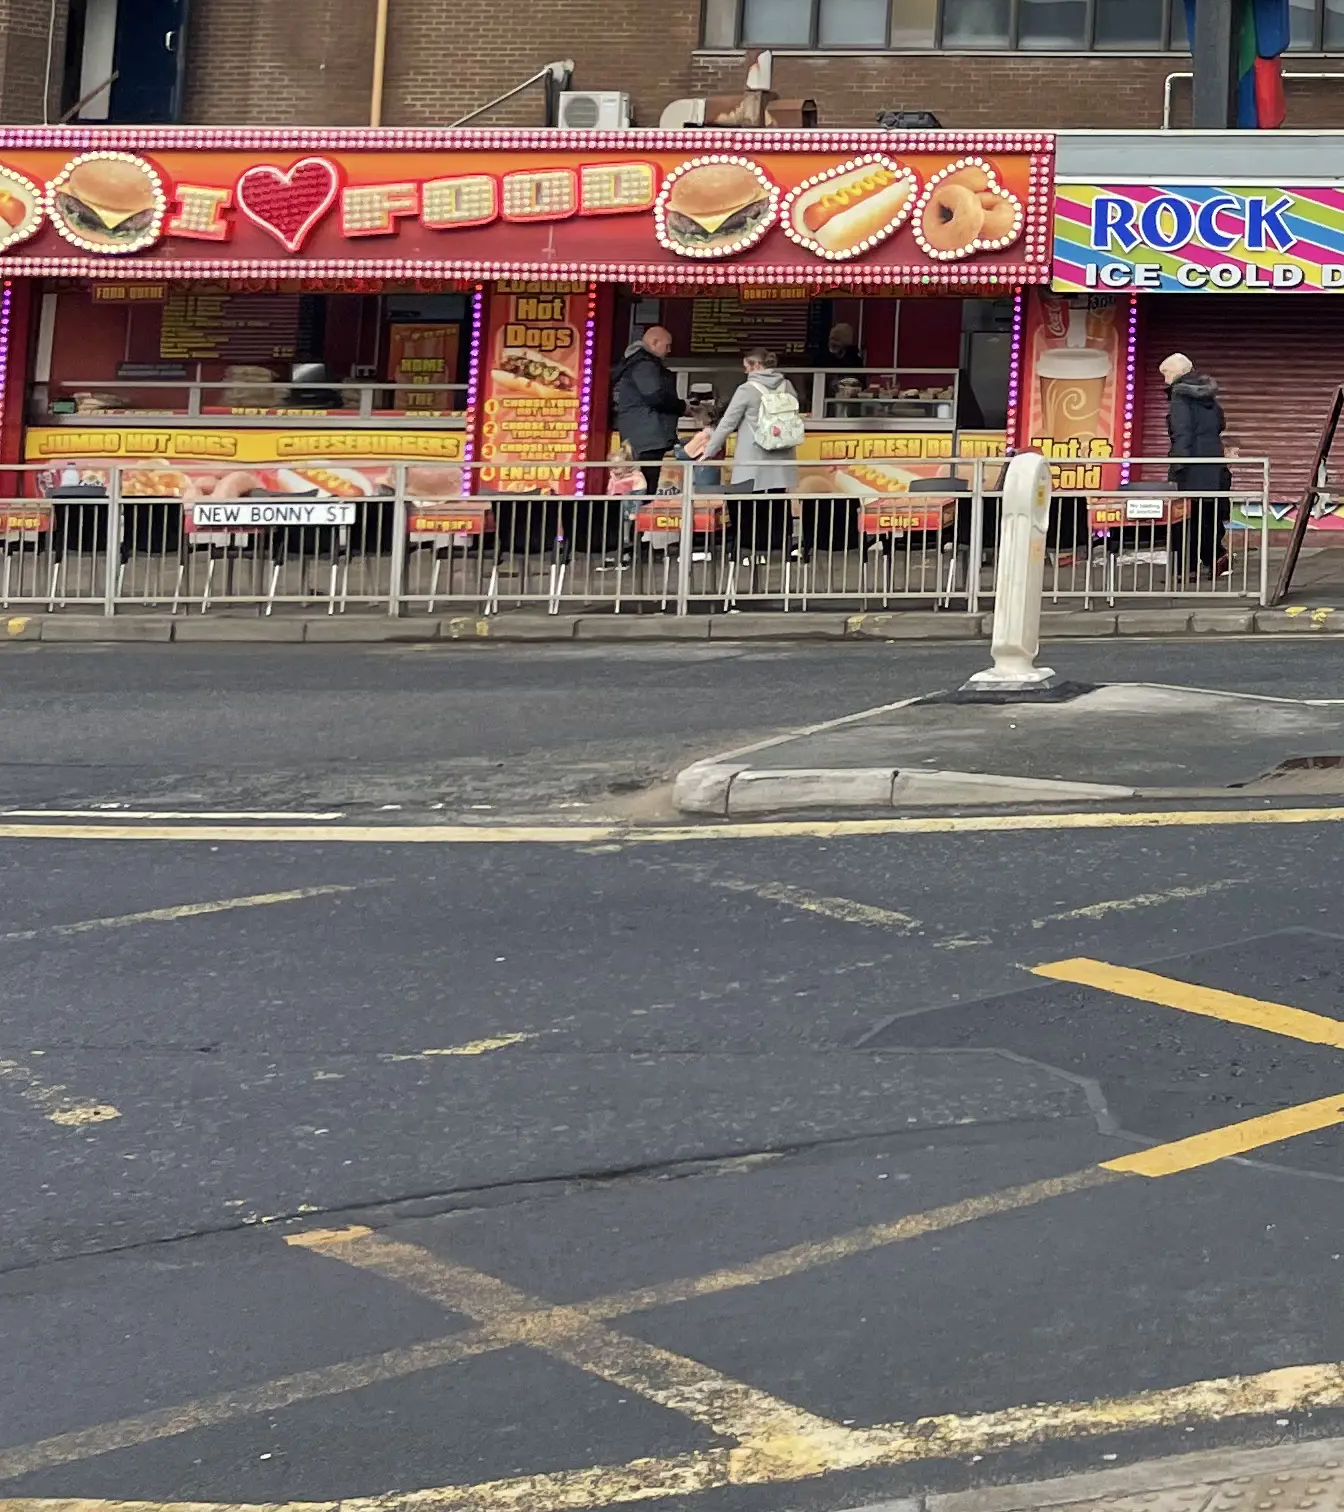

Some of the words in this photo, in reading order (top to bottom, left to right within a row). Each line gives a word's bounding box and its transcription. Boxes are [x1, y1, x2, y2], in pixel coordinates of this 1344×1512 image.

[167, 183, 233, 242] I
[339, 161, 657, 238] FOOD
[1089, 194, 1299, 254] ROCK
[1085, 263, 1162, 288] ICE
[1176, 263, 1305, 289] COLD
[516, 297, 564, 320] Hot
[505, 324, 572, 351] Dogs
[502, 399, 547, 410] CHOOSE
[501, 421, 546, 432] CHOOSE
[40, 433, 121, 455] JUMBO
[125, 433, 172, 455] HOT
[174, 434, 238, 457] DOGS
[276, 435, 460, 458] CHEESEBURGERS
[500, 444, 546, 454] CHOOSE
[820, 440, 860, 458] HOT
[863, 439, 921, 457] FRESH
[500, 466, 572, 482] ENJOY!
[199, 506, 241, 523] NEW
[251, 506, 315, 523] BONNY
[327, 506, 350, 522] ST
[656, 516, 683, 528] Chi
[878, 515, 921, 529] Chips
